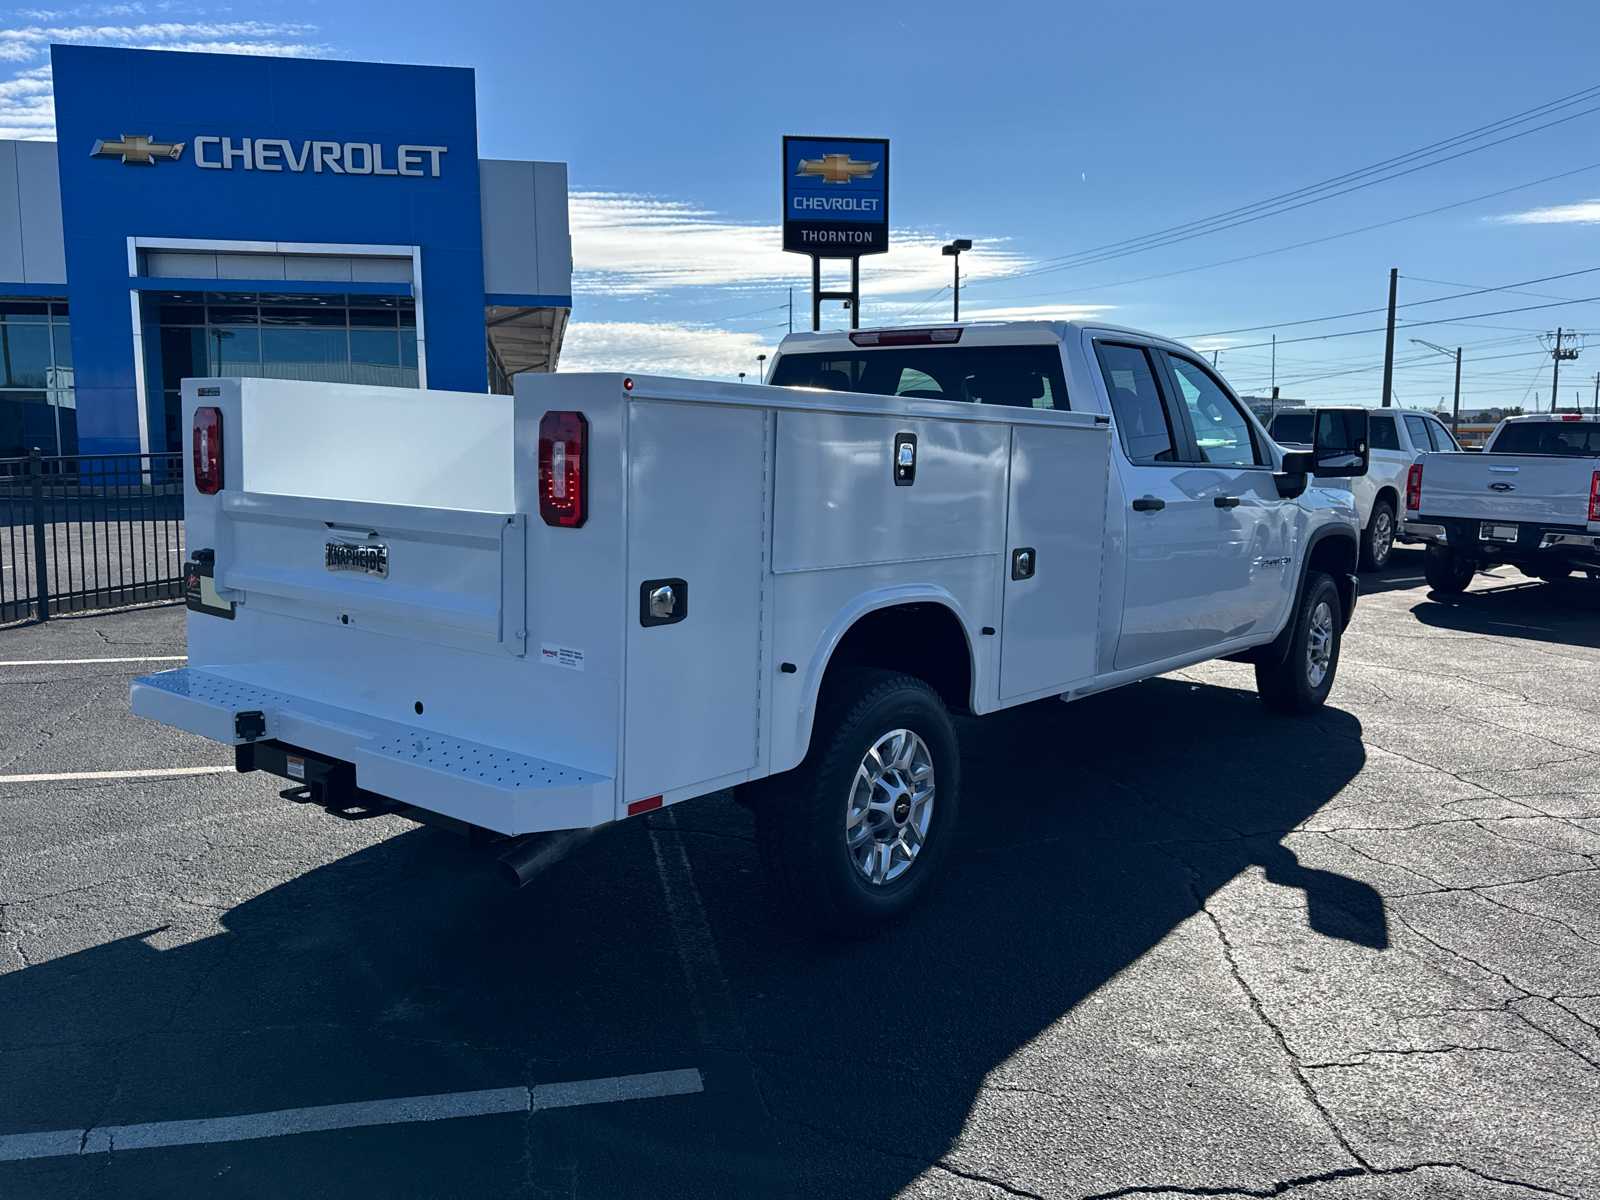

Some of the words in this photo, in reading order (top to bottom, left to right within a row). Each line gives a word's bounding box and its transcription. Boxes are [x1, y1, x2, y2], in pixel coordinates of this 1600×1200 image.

[194, 136, 448, 177] CHEVROLET
[793, 196, 879, 211] CHEVROLET
[801, 230, 873, 243] THORNTON
[327, 542, 384, 574] KNAPHEIDE
